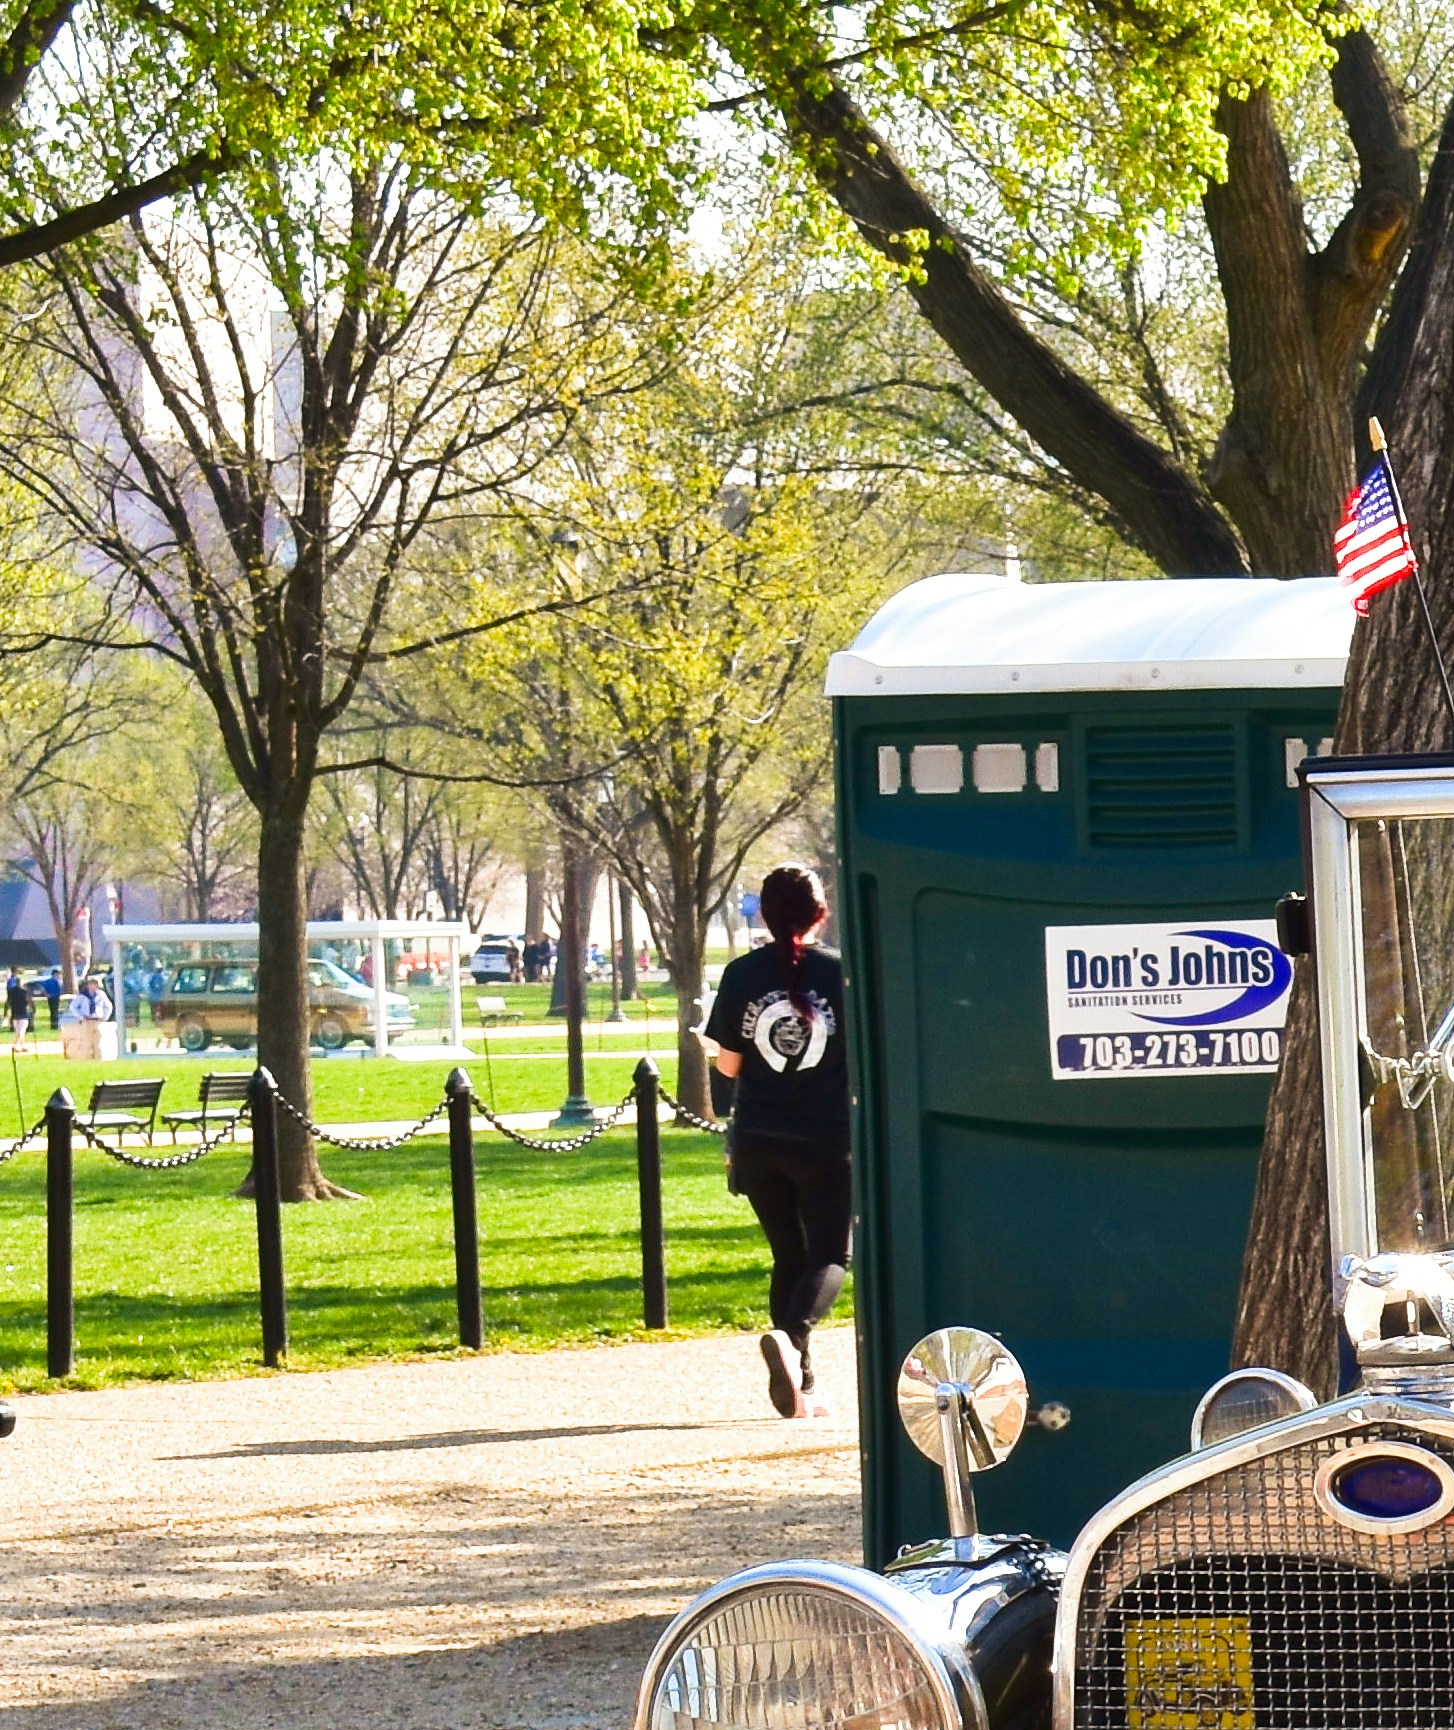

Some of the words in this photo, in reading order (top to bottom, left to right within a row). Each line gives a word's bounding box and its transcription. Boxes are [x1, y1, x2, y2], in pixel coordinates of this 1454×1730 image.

[1066, 947, 1160, 990] Don's
[1168, 944, 1273, 986] Johns
[1068, 994, 1128, 1008] SANITATION
[1132, 993, 1183, 1006] SERVICES
[1079, 1031, 1280, 1069] 703-273-7100
